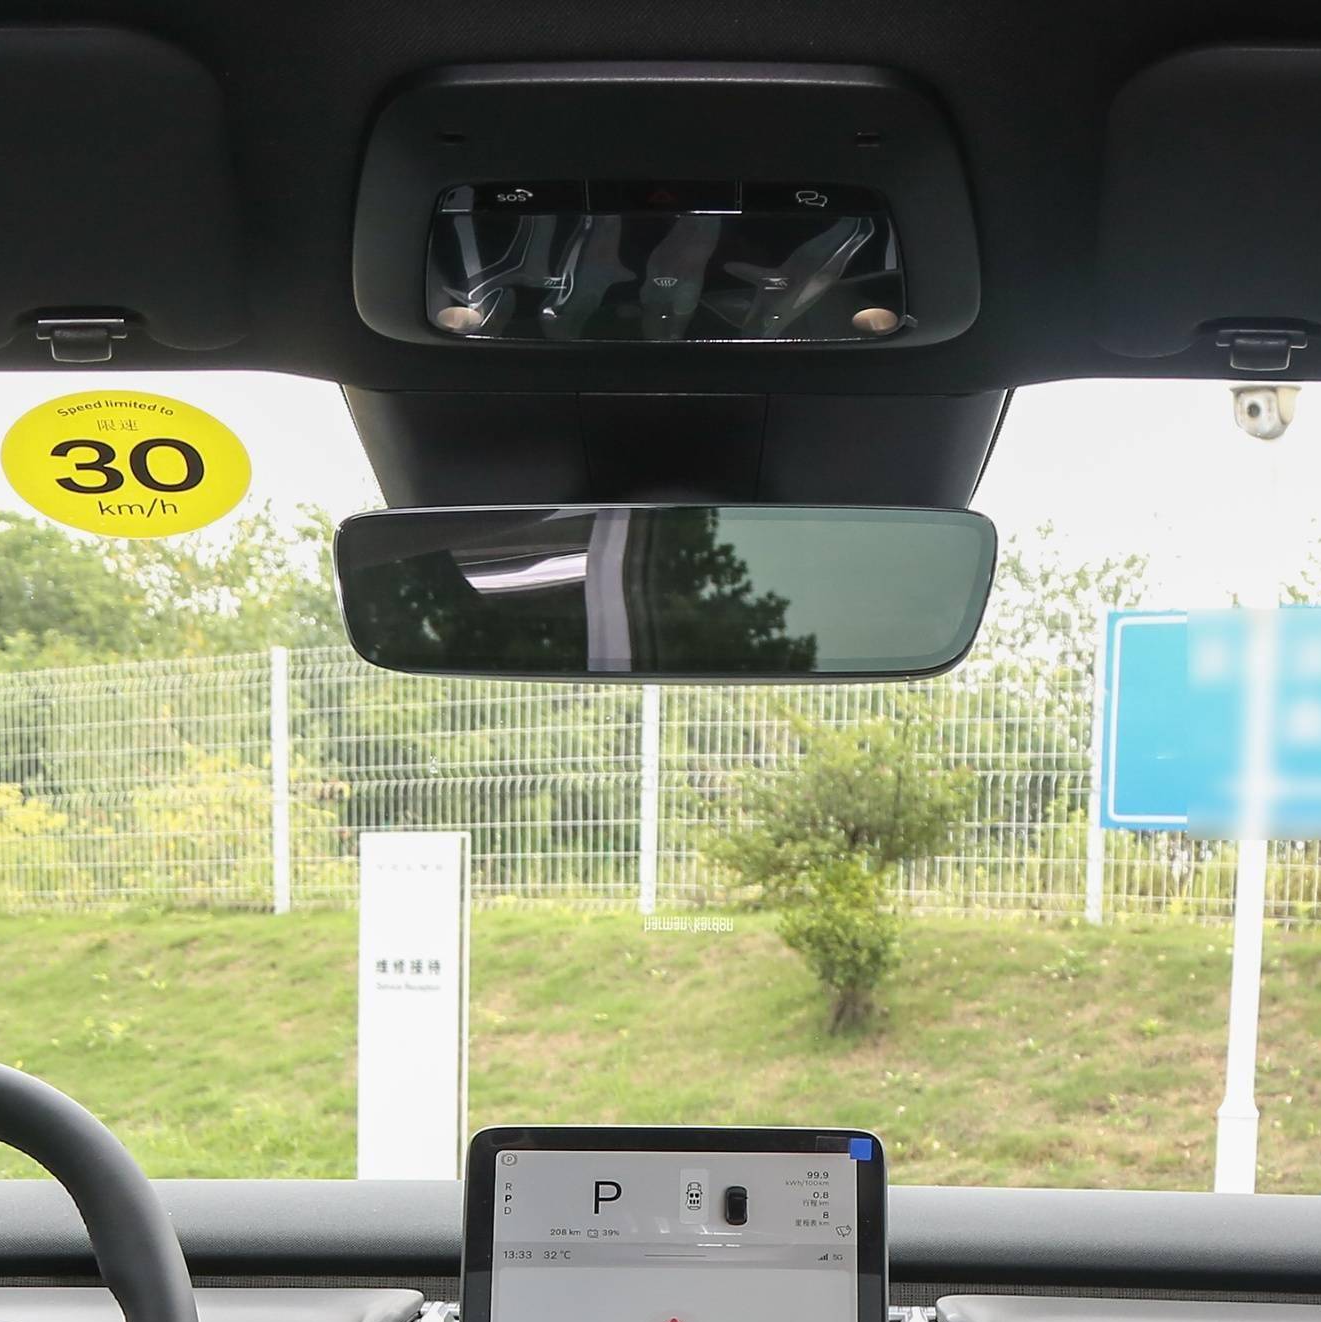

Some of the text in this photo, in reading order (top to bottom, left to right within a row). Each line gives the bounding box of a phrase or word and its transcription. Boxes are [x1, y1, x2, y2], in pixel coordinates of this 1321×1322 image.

[496, 193, 526, 202] SOS
[57, 399, 175, 417] Speed limited to
[97, 418, 139, 432] 限速
[50, 438, 205, 495] 30
[98, 497, 178, 518] km/h
[806, 1171, 829, 1180] 99.9
[505, 1183, 512, 1191] R
[504, 1194, 512, 1203] P
[594, 1180, 622, 1214] P
[813, 1191, 829, 1199] 0.8
[504, 1207, 512, 1215] D
[822, 1211, 829, 1219] 8
[550, 1228, 567, 1236] 208
[569, 1228, 581, 1236] km
[503, 1250, 571, 1260] 13:33 32 °C
